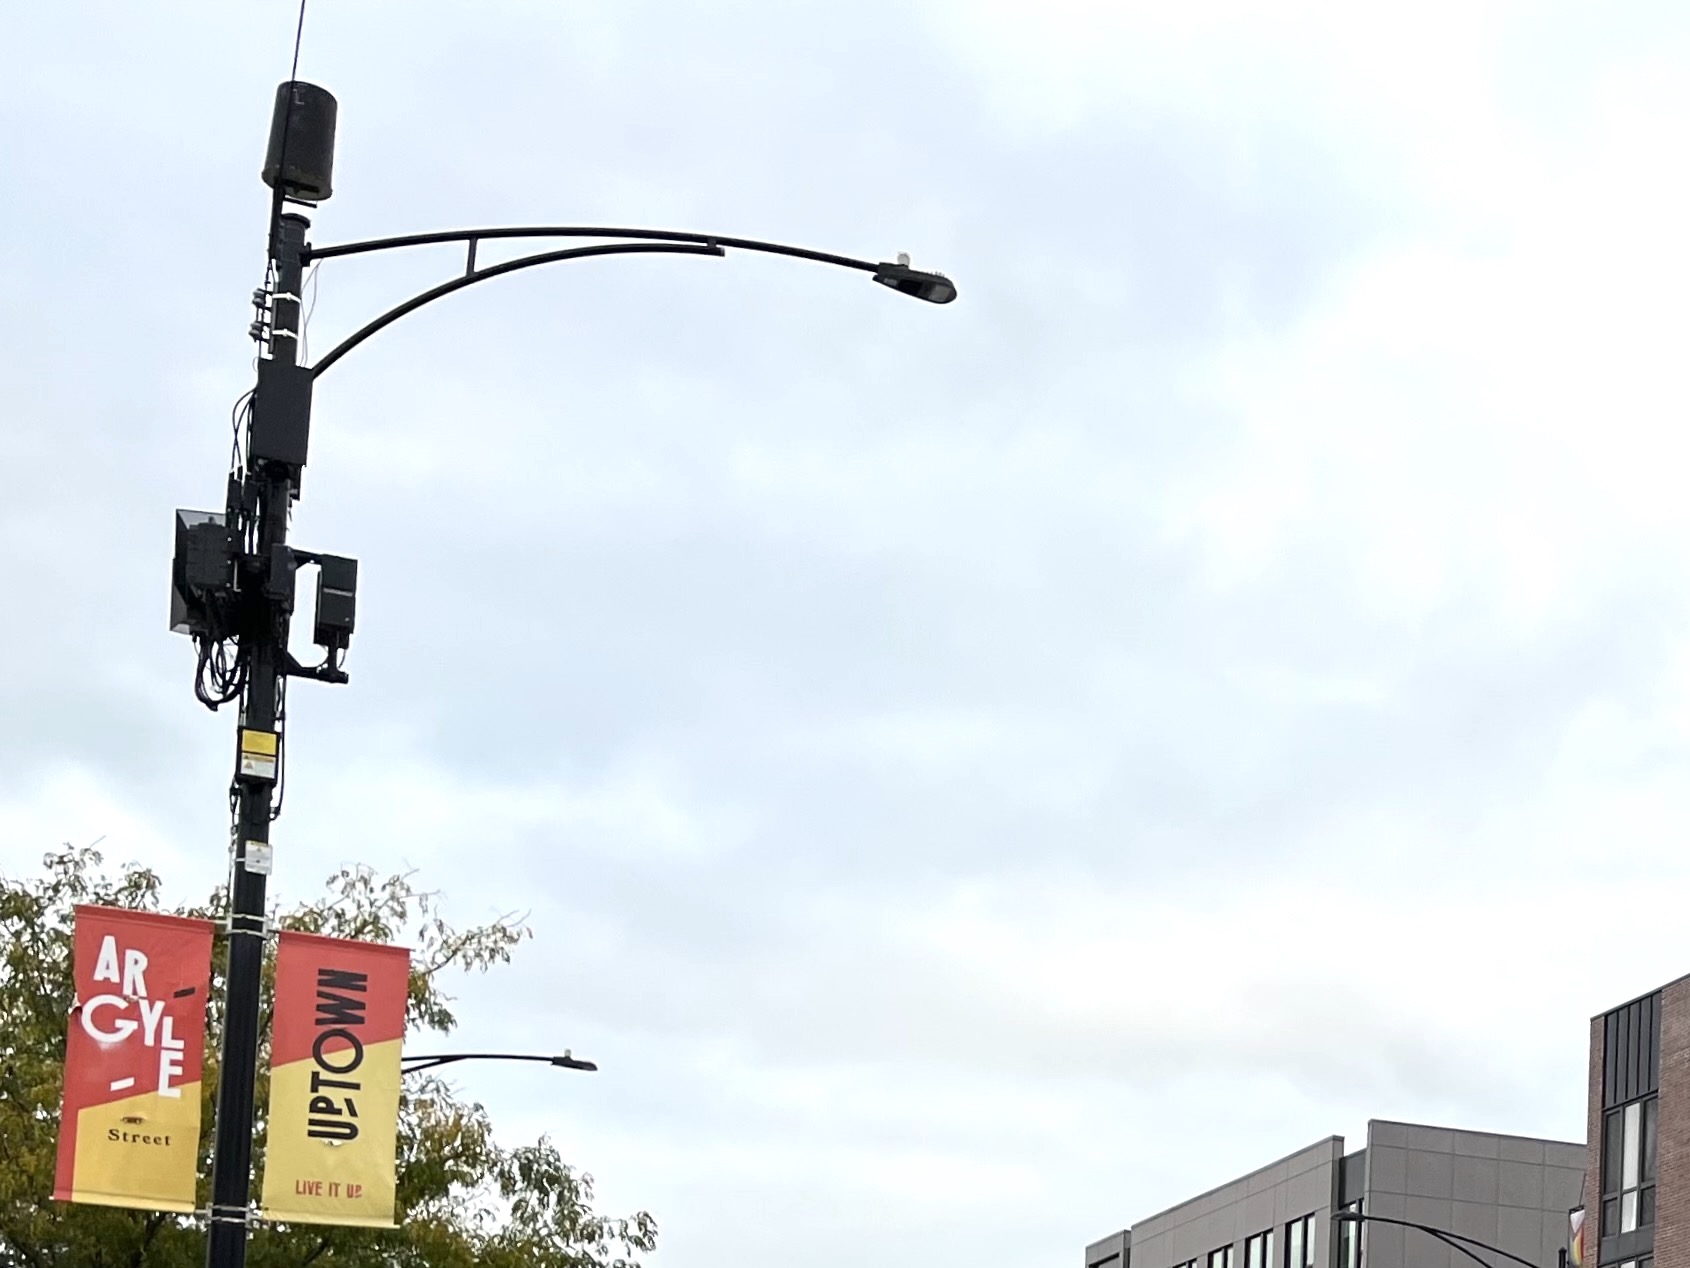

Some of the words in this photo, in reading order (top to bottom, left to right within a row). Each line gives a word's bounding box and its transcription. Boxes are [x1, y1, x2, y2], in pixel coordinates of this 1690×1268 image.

[307, 968, 368, 1141] UPTOWN
[108, 1128, 171, 1147] Street
[295, 1179, 323, 1197] LIVE
[328, 1182, 341, 1198] IT
[346, 1183, 363, 1199] UP
